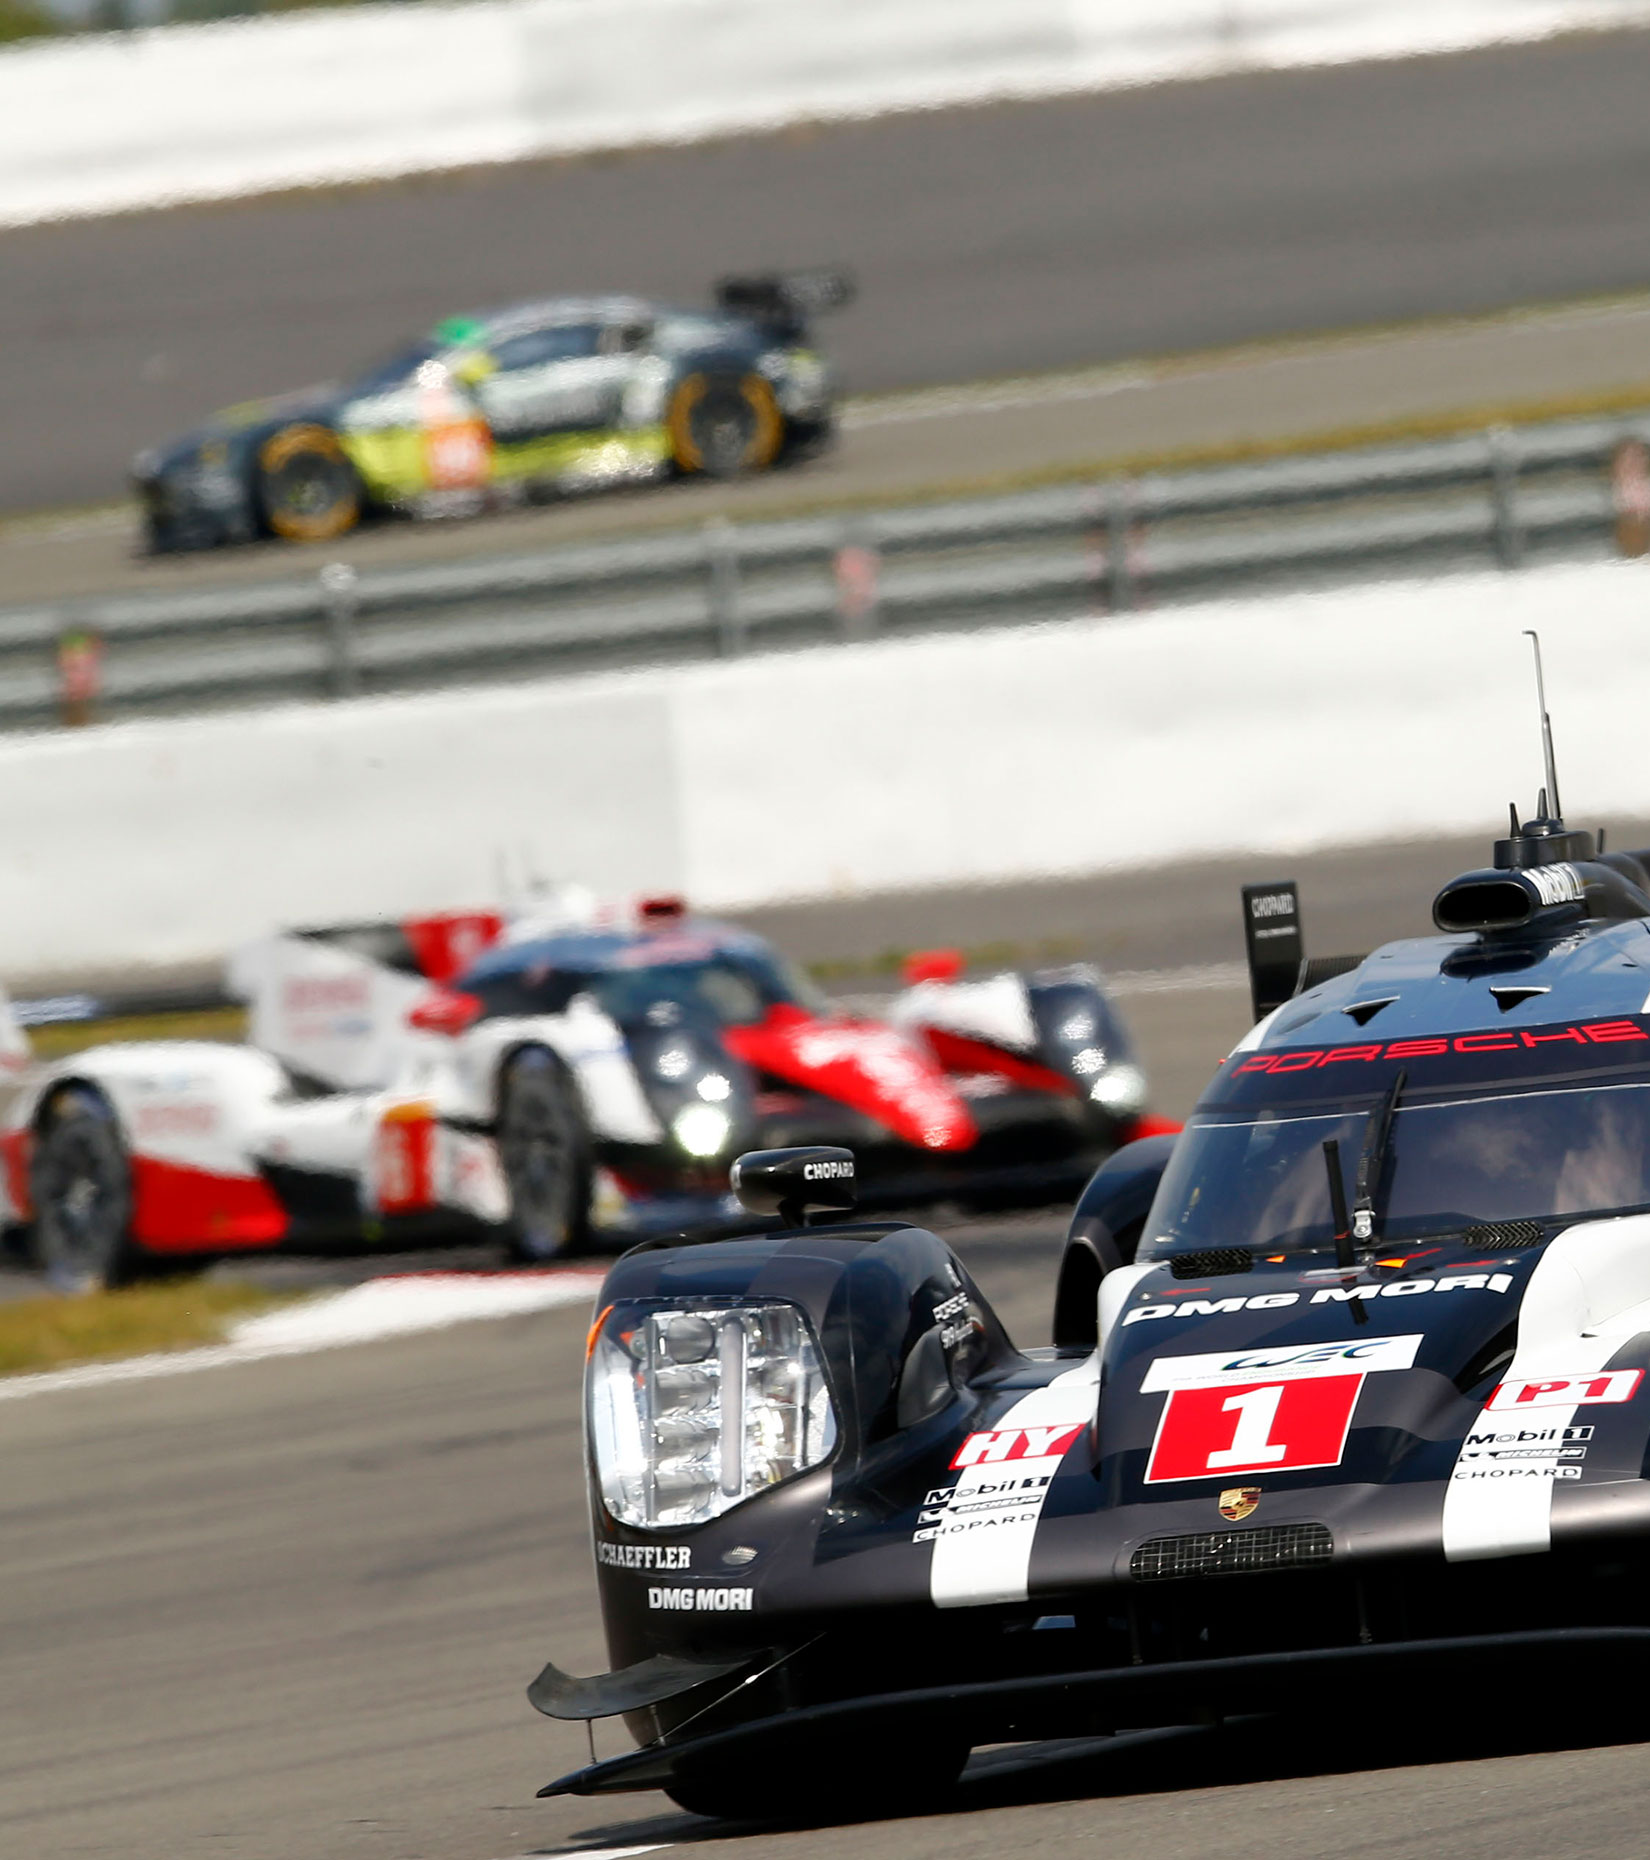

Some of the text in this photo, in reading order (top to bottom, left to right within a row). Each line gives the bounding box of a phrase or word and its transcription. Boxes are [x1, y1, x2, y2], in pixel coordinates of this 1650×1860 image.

[1230, 1020, 1650, 1078] PORSCHE
[804, 1161, 855, 1180] CHOPARD
[1122, 1273, 1514, 1327] DMG MORI
[1221, 1340, 1393, 1372] WEC
[1515, 1376, 1613, 1403] P1
[1205, 1385, 1287, 1470] 1
[1465, 1427, 1592, 1445] Mobil 1
[954, 1424, 1081, 1467] HY
[1495, 1447, 1584, 1459] MICHELIN
[1454, 1467, 1579, 1480] CHOPARD
[927, 1476, 1051, 1504] Mobil 1
[916, 1512, 1037, 1541] CHOPARD
[648, 1587, 753, 1611] DMG MORI
